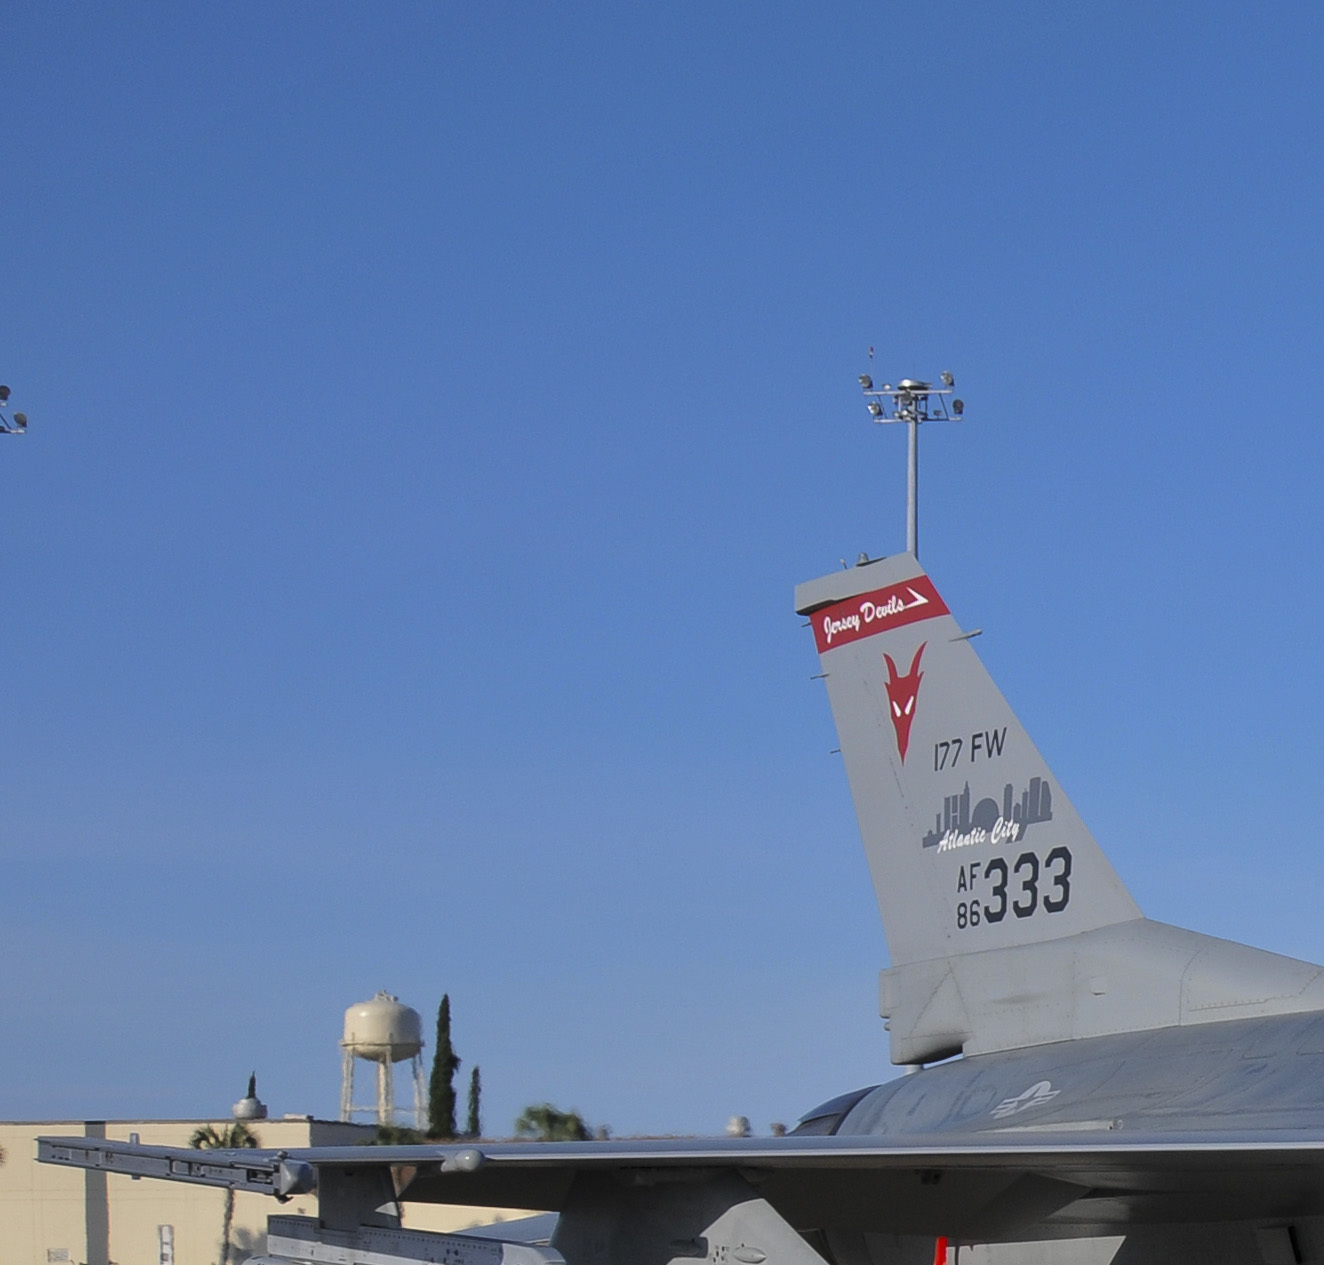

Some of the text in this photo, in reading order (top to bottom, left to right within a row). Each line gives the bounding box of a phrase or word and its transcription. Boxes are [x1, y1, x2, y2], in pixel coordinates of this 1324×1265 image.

[823, 594, 905, 644] Jersey Devils
[934, 727, 1008, 772] 177 FW
[936, 816, 1020, 854] Atlantic City
[957, 862, 981, 894] AF
[983, 846, 1073, 924] 333
[956, 900, 981, 930] 86
